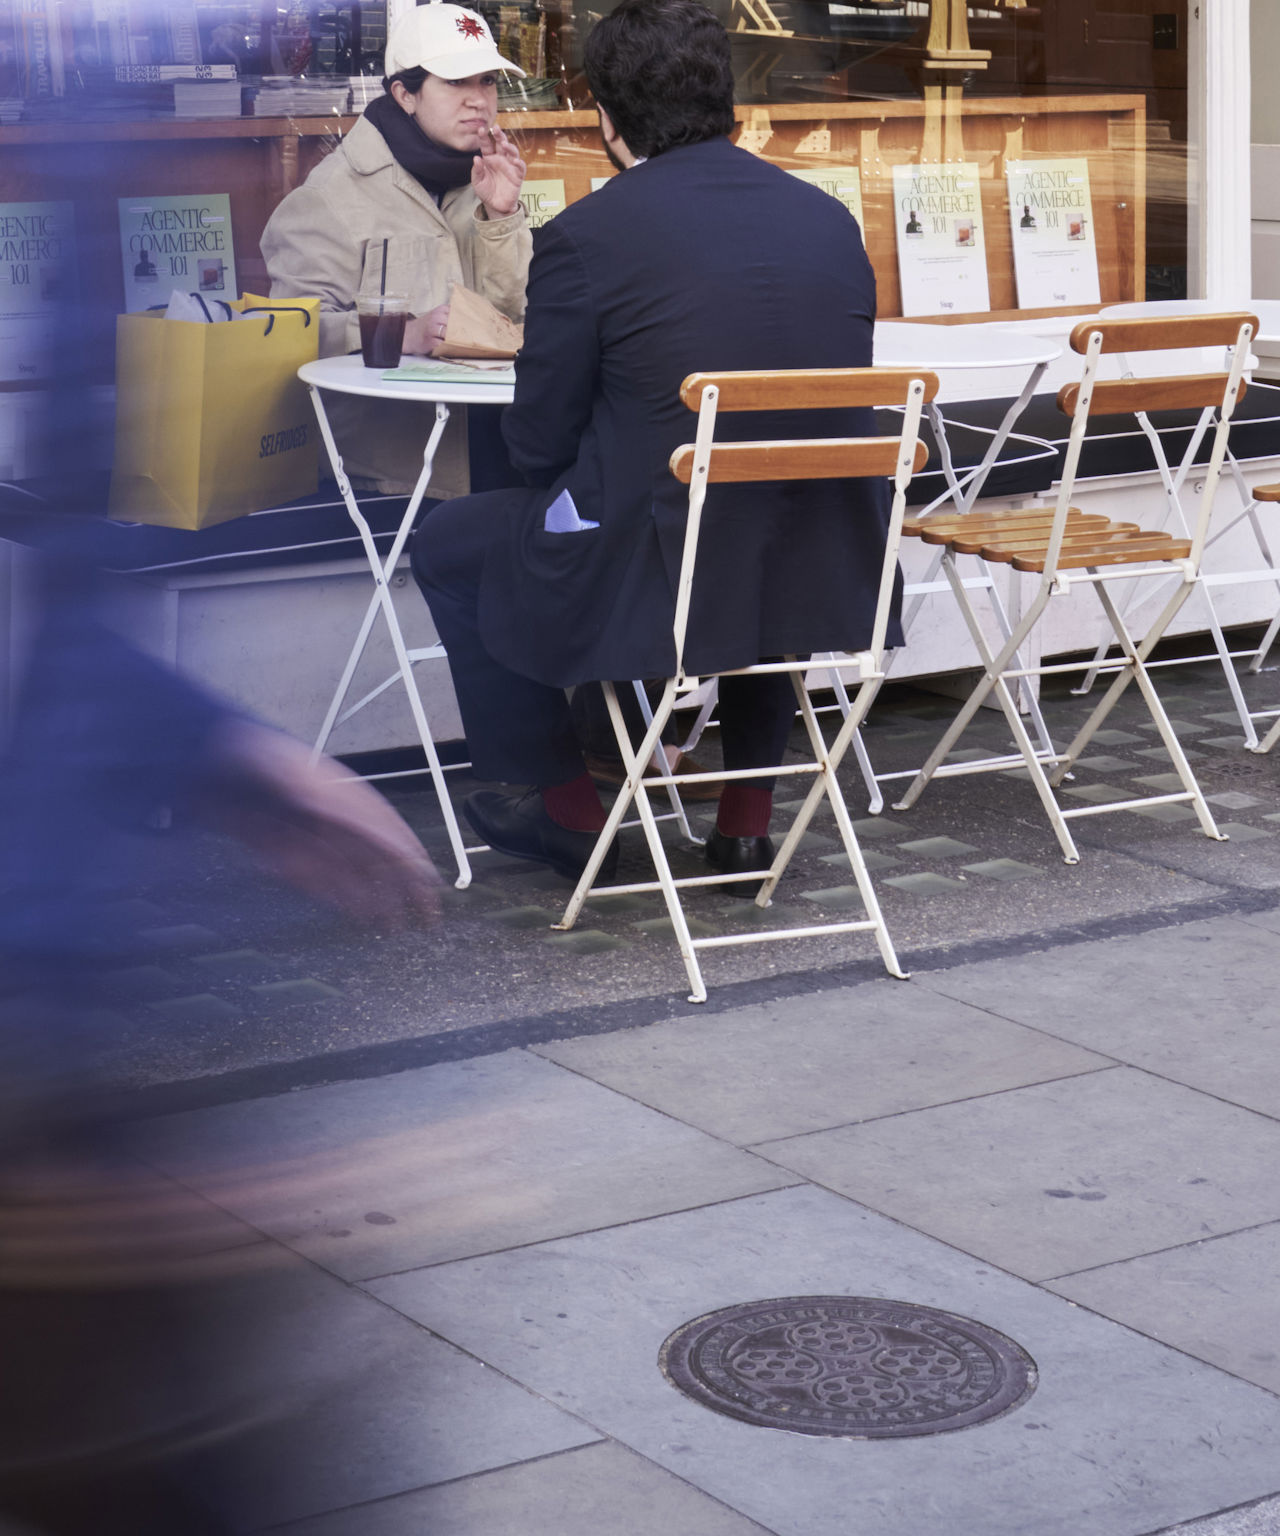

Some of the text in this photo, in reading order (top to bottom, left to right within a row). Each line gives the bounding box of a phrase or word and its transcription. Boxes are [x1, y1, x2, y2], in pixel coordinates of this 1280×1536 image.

[911, 175, 964, 194] AGENTIC
[1024, 170, 1075, 189] AGENTIC
[902, 195, 975, 214] COMMERCE
[1016, 190, 1085, 208] COMMERCE
[141, 208, 211, 231] AGENTIC
[130, 231, 224, 253] COMMERCE
[169, 256, 188, 276] 101
[259, 424, 308, 458] SELFRIDGES
